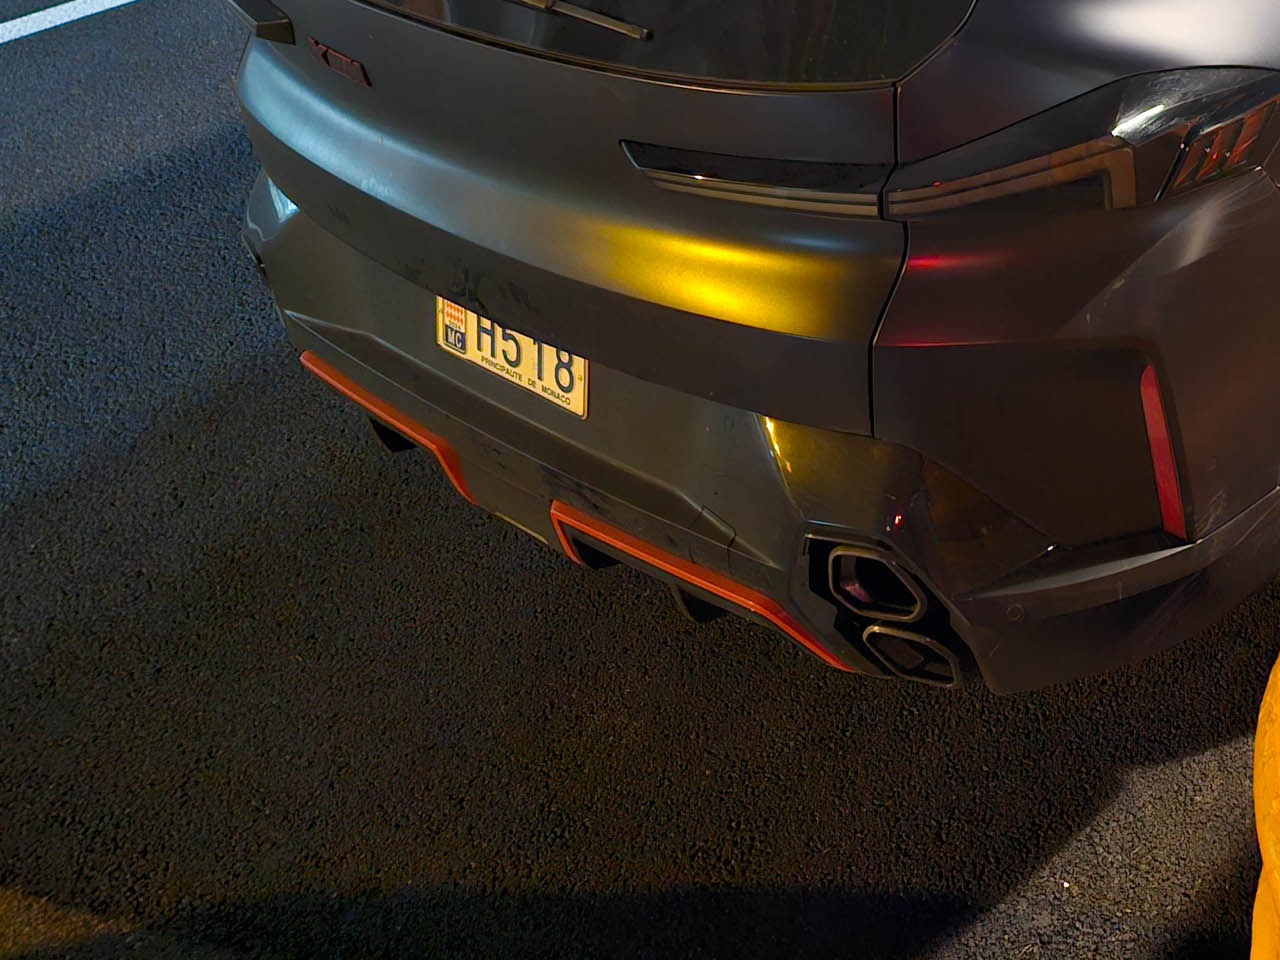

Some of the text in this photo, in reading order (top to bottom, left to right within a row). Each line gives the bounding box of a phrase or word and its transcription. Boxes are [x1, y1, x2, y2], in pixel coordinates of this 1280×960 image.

[447, 327, 463, 348] MC
[527, 377, 538, 389] DE
[541, 385, 571, 406] MONACO
